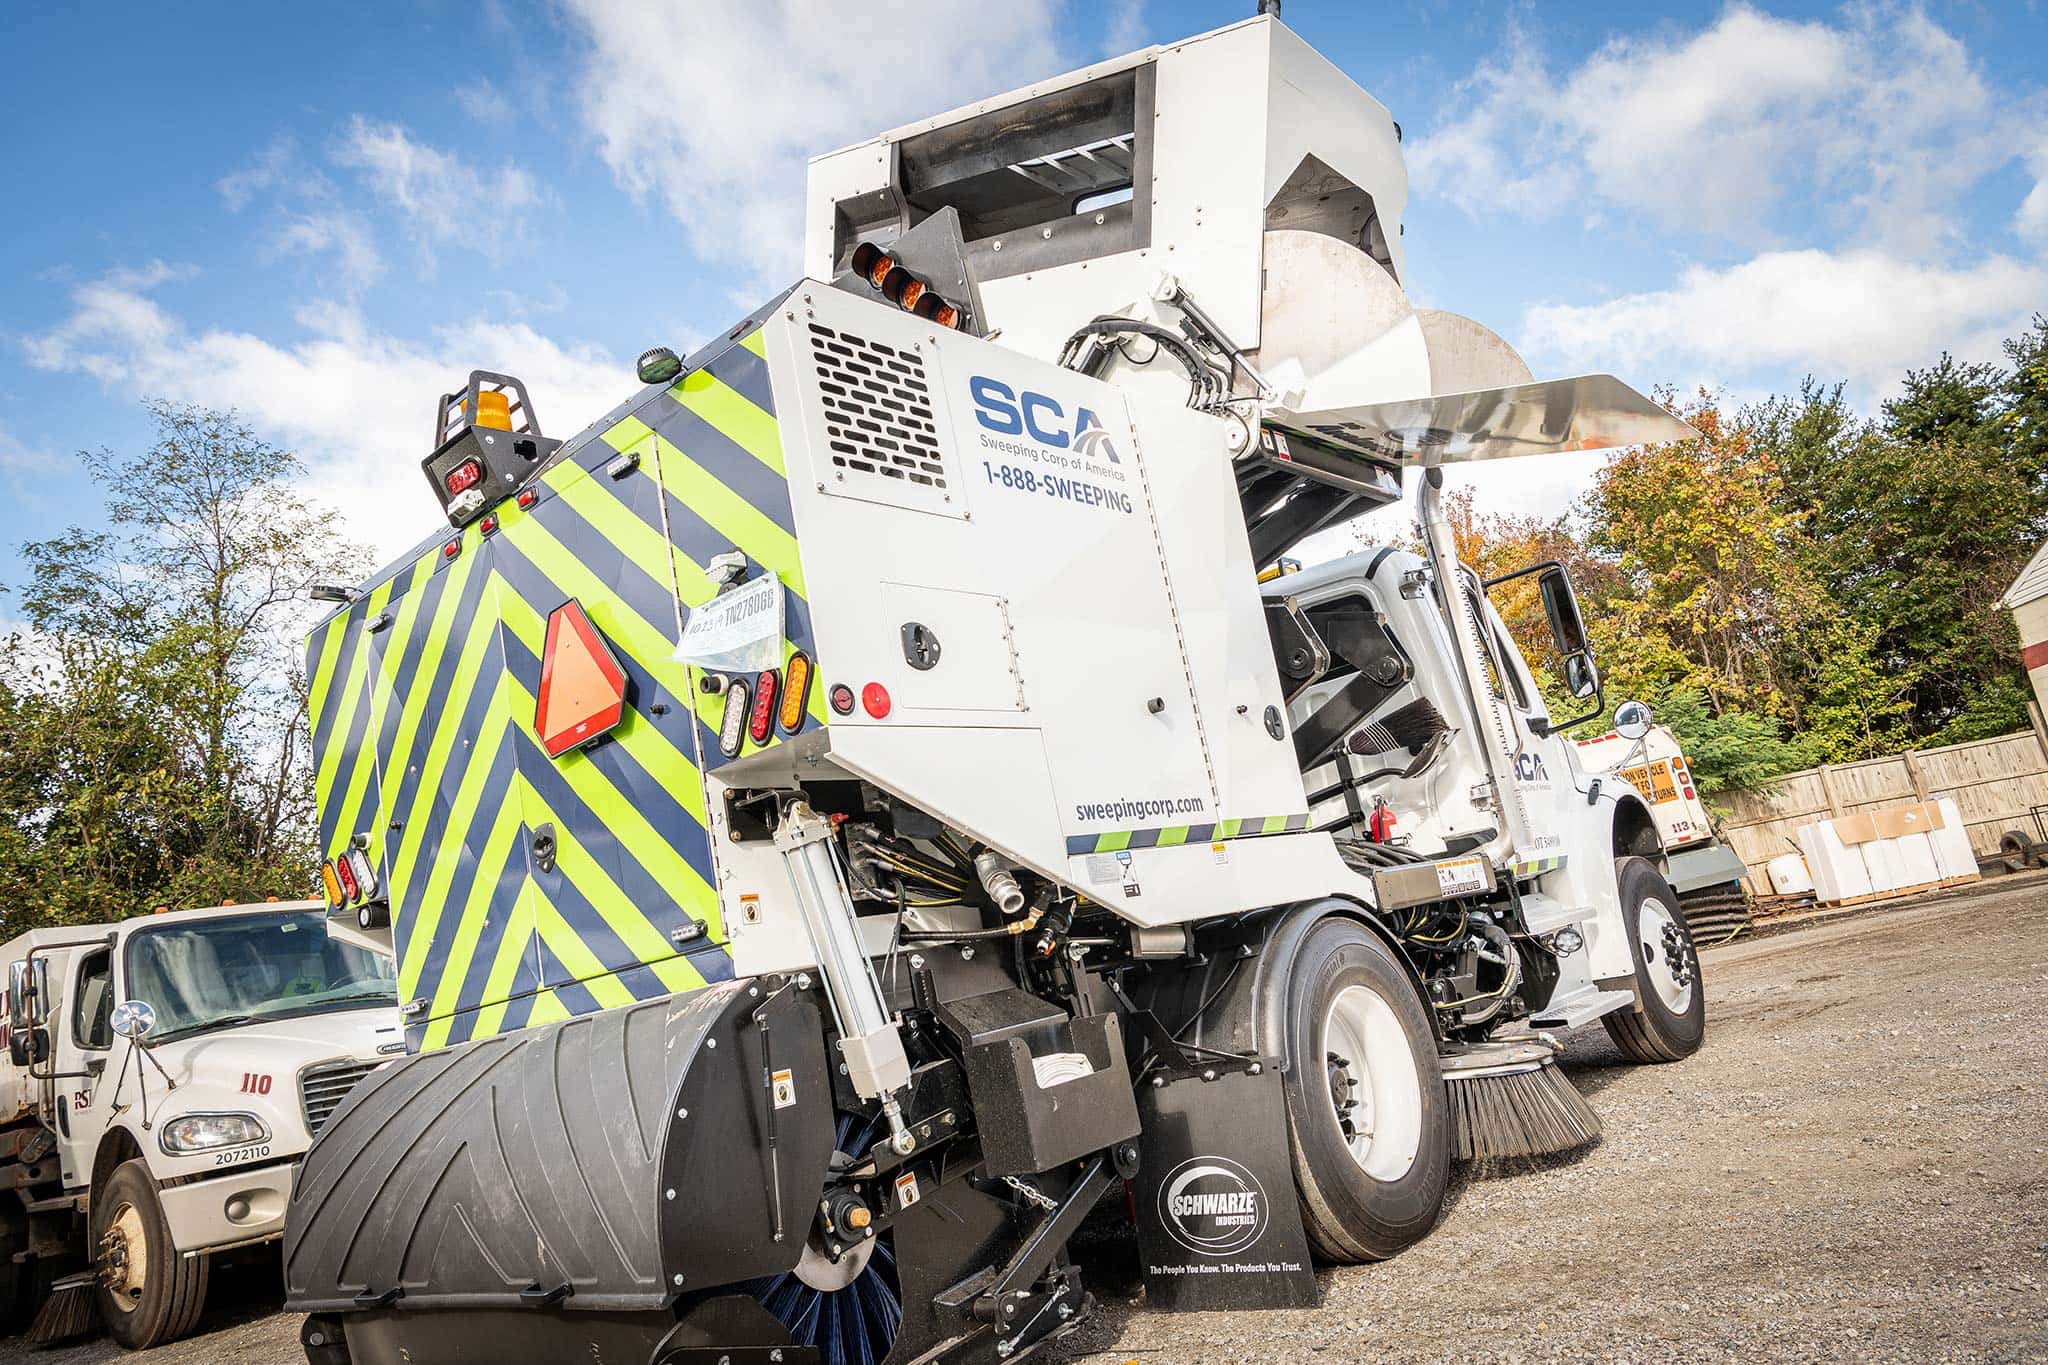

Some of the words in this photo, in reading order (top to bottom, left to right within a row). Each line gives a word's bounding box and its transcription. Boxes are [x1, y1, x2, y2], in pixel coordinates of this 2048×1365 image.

[970, 375, 1121, 464] SCA
[980, 434, 1039, 462] Sweeping
[1041, 450, 1068, 470] Corp
[1071, 458, 1082, 471] of
[1085, 461, 1126, 482] America
[983, 461, 1133, 514] 1-888-SWEEPING
[1514, 753, 1549, 781] CA
[1076, 797, 1204, 822] sweepingcorp.com
[1672, 821, 1690, 833] 113
[240, 1072, 272, 1095] 110
[215, 1145, 270, 1165] 2072110
[1174, 1191, 1258, 1216] SCHWARZE
[1215, 1214, 1256, 1226] INDUSTRIES
[1150, 1265, 1162, 1275] The
[1162, 1265, 1185, 1276] People
[1186, 1264, 1199, 1274] You
[1199, 1264, 1220, 1274] Know.
[1221, 1263, 1235, 1273] The
[1235, 1262, 1266, 1273] Products
[1266, 1262, 1281, 1272] You
[1281, 1261, 1302, 1272] Trust.
